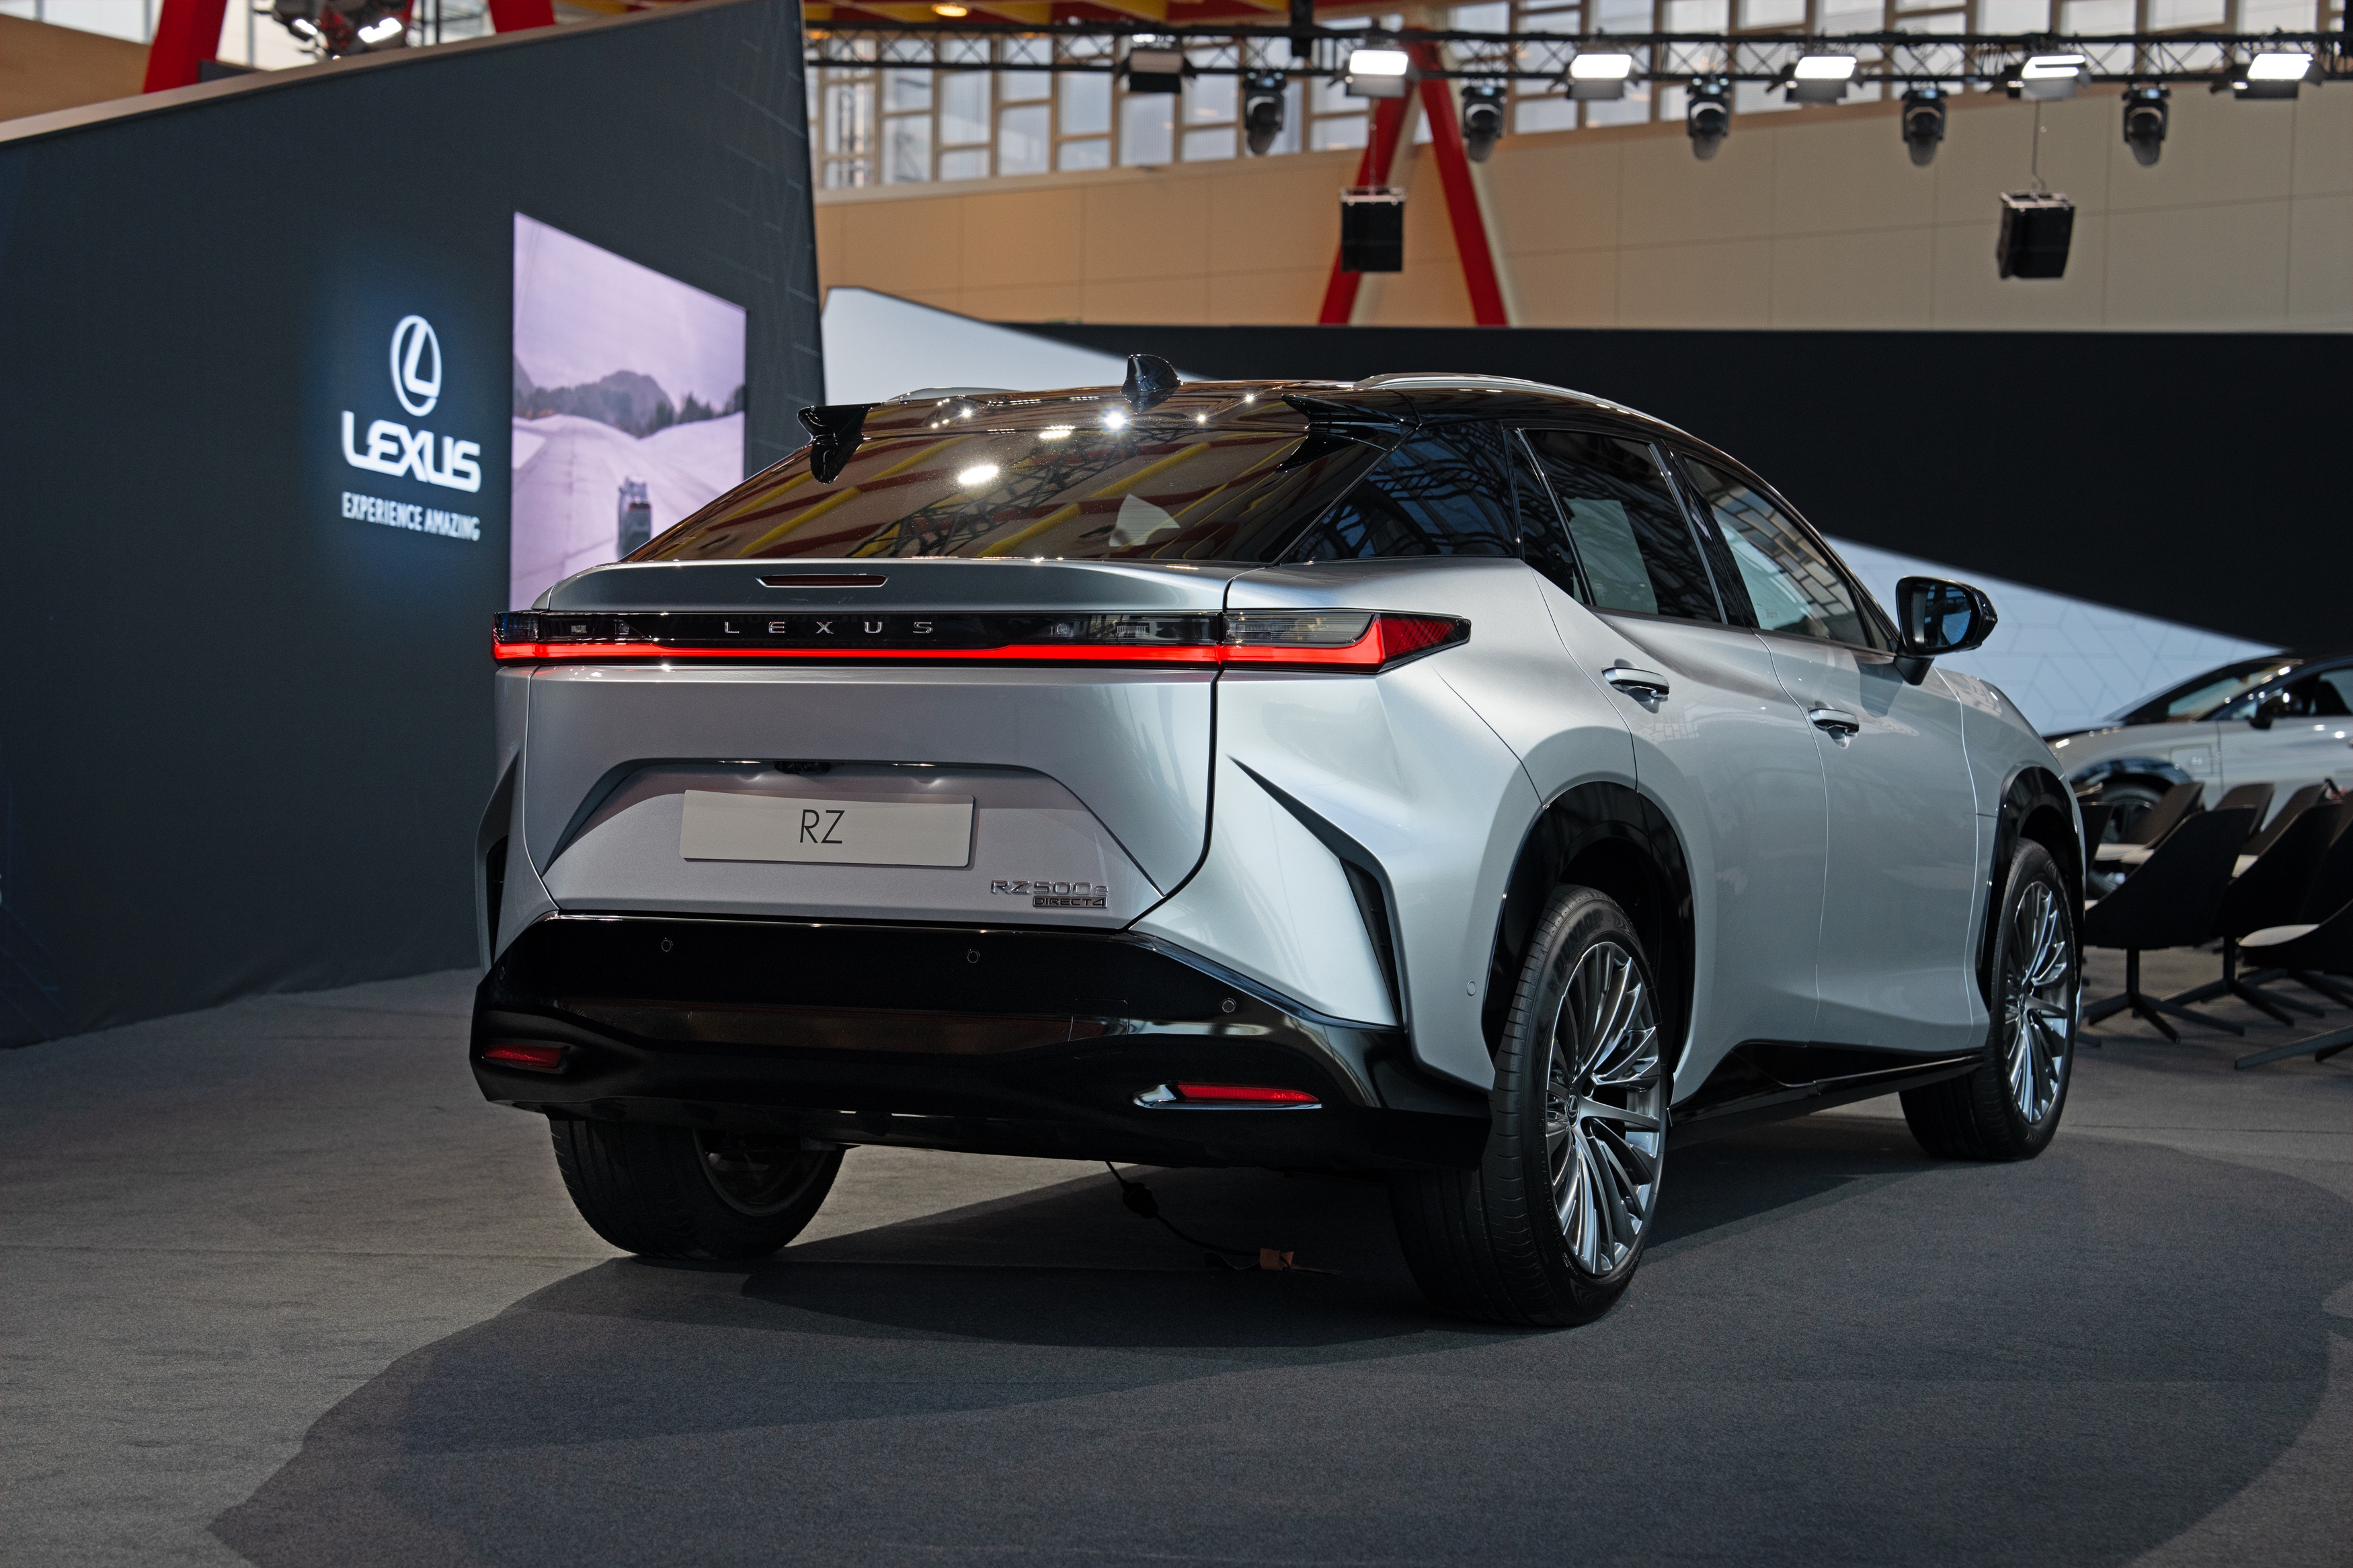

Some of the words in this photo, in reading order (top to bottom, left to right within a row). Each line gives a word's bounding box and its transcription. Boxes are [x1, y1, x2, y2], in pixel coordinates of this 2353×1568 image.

[342, 411, 481, 493] LEXUS
[342, 493, 423, 531] EXPERIENCE
[424, 509, 481, 541] AMAZING
[724, 620, 934, 634] LEXUS
[799, 809, 846, 844] RZ
[1033, 897, 1106, 907] DIRECT4
[1552, 908, 1604, 984] DUNLOP
